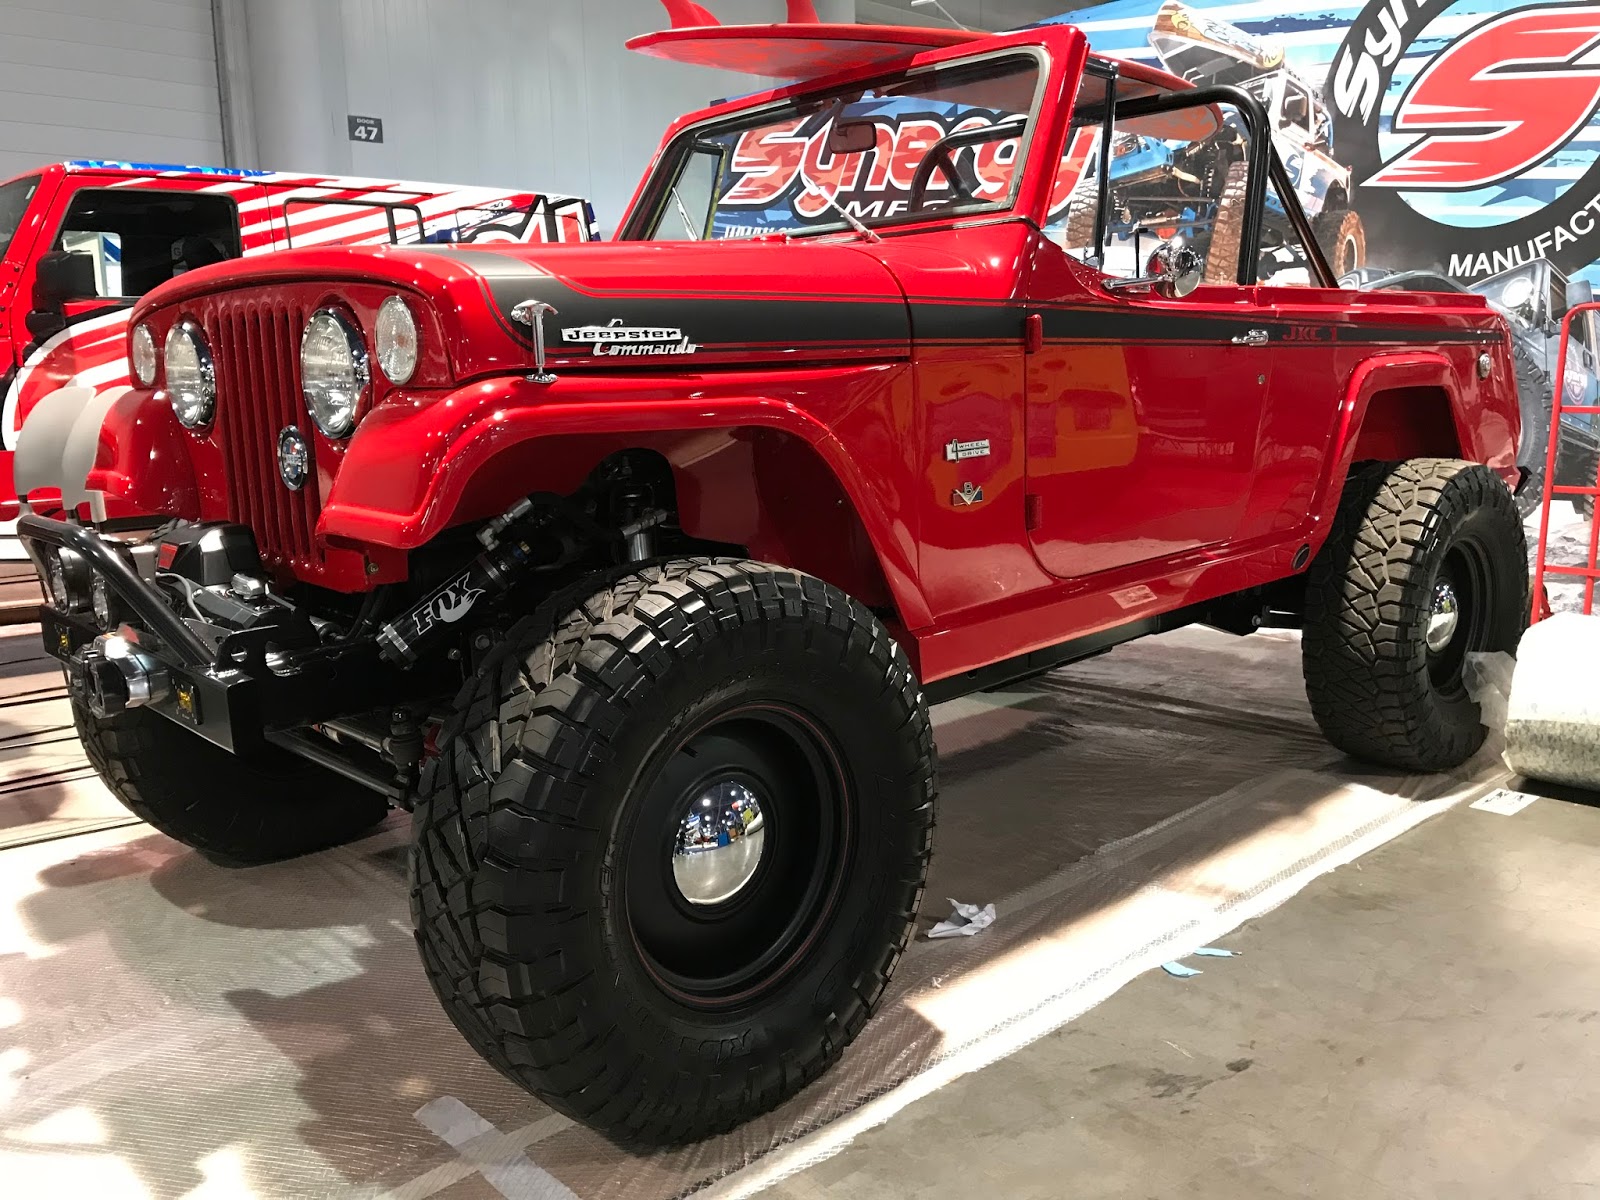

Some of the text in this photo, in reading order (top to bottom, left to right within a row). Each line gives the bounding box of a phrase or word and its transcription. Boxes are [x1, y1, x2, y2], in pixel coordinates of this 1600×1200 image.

[354, 126, 378, 140] 47
[566, 328, 679, 341] Jeepster
[593, 322, 703, 356] Commando
[412, 571, 482, 635] FOX
